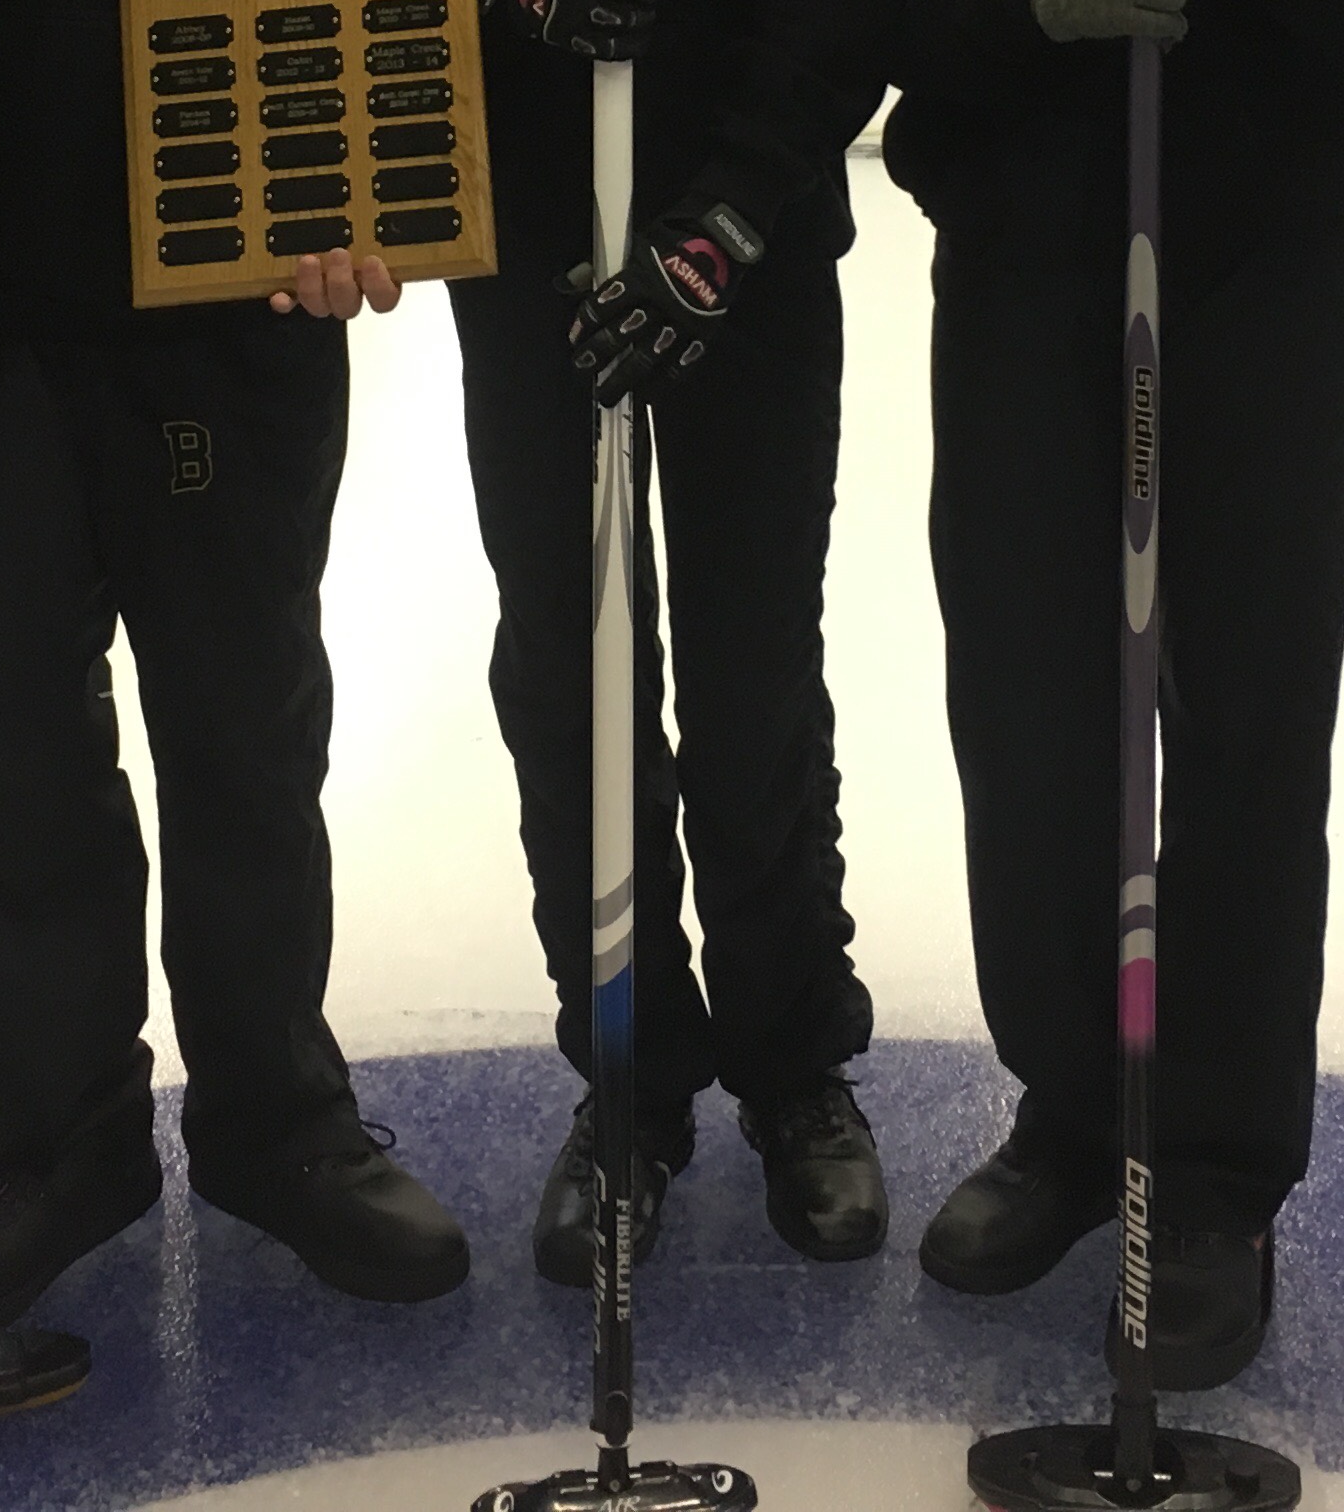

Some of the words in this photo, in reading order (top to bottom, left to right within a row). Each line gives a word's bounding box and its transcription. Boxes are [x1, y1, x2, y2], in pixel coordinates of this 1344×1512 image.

[376, 58, 405, 70] 2013
[425, 56, 438, 66] 14
[664, 254, 718, 306] ASHAM
[162, 421, 213, 495] B
[1133, 365, 1154, 500] Goldline
[616, 1198, 631, 1321] FIBERLITE
[1123, 1157, 1154, 1349] Goldline
